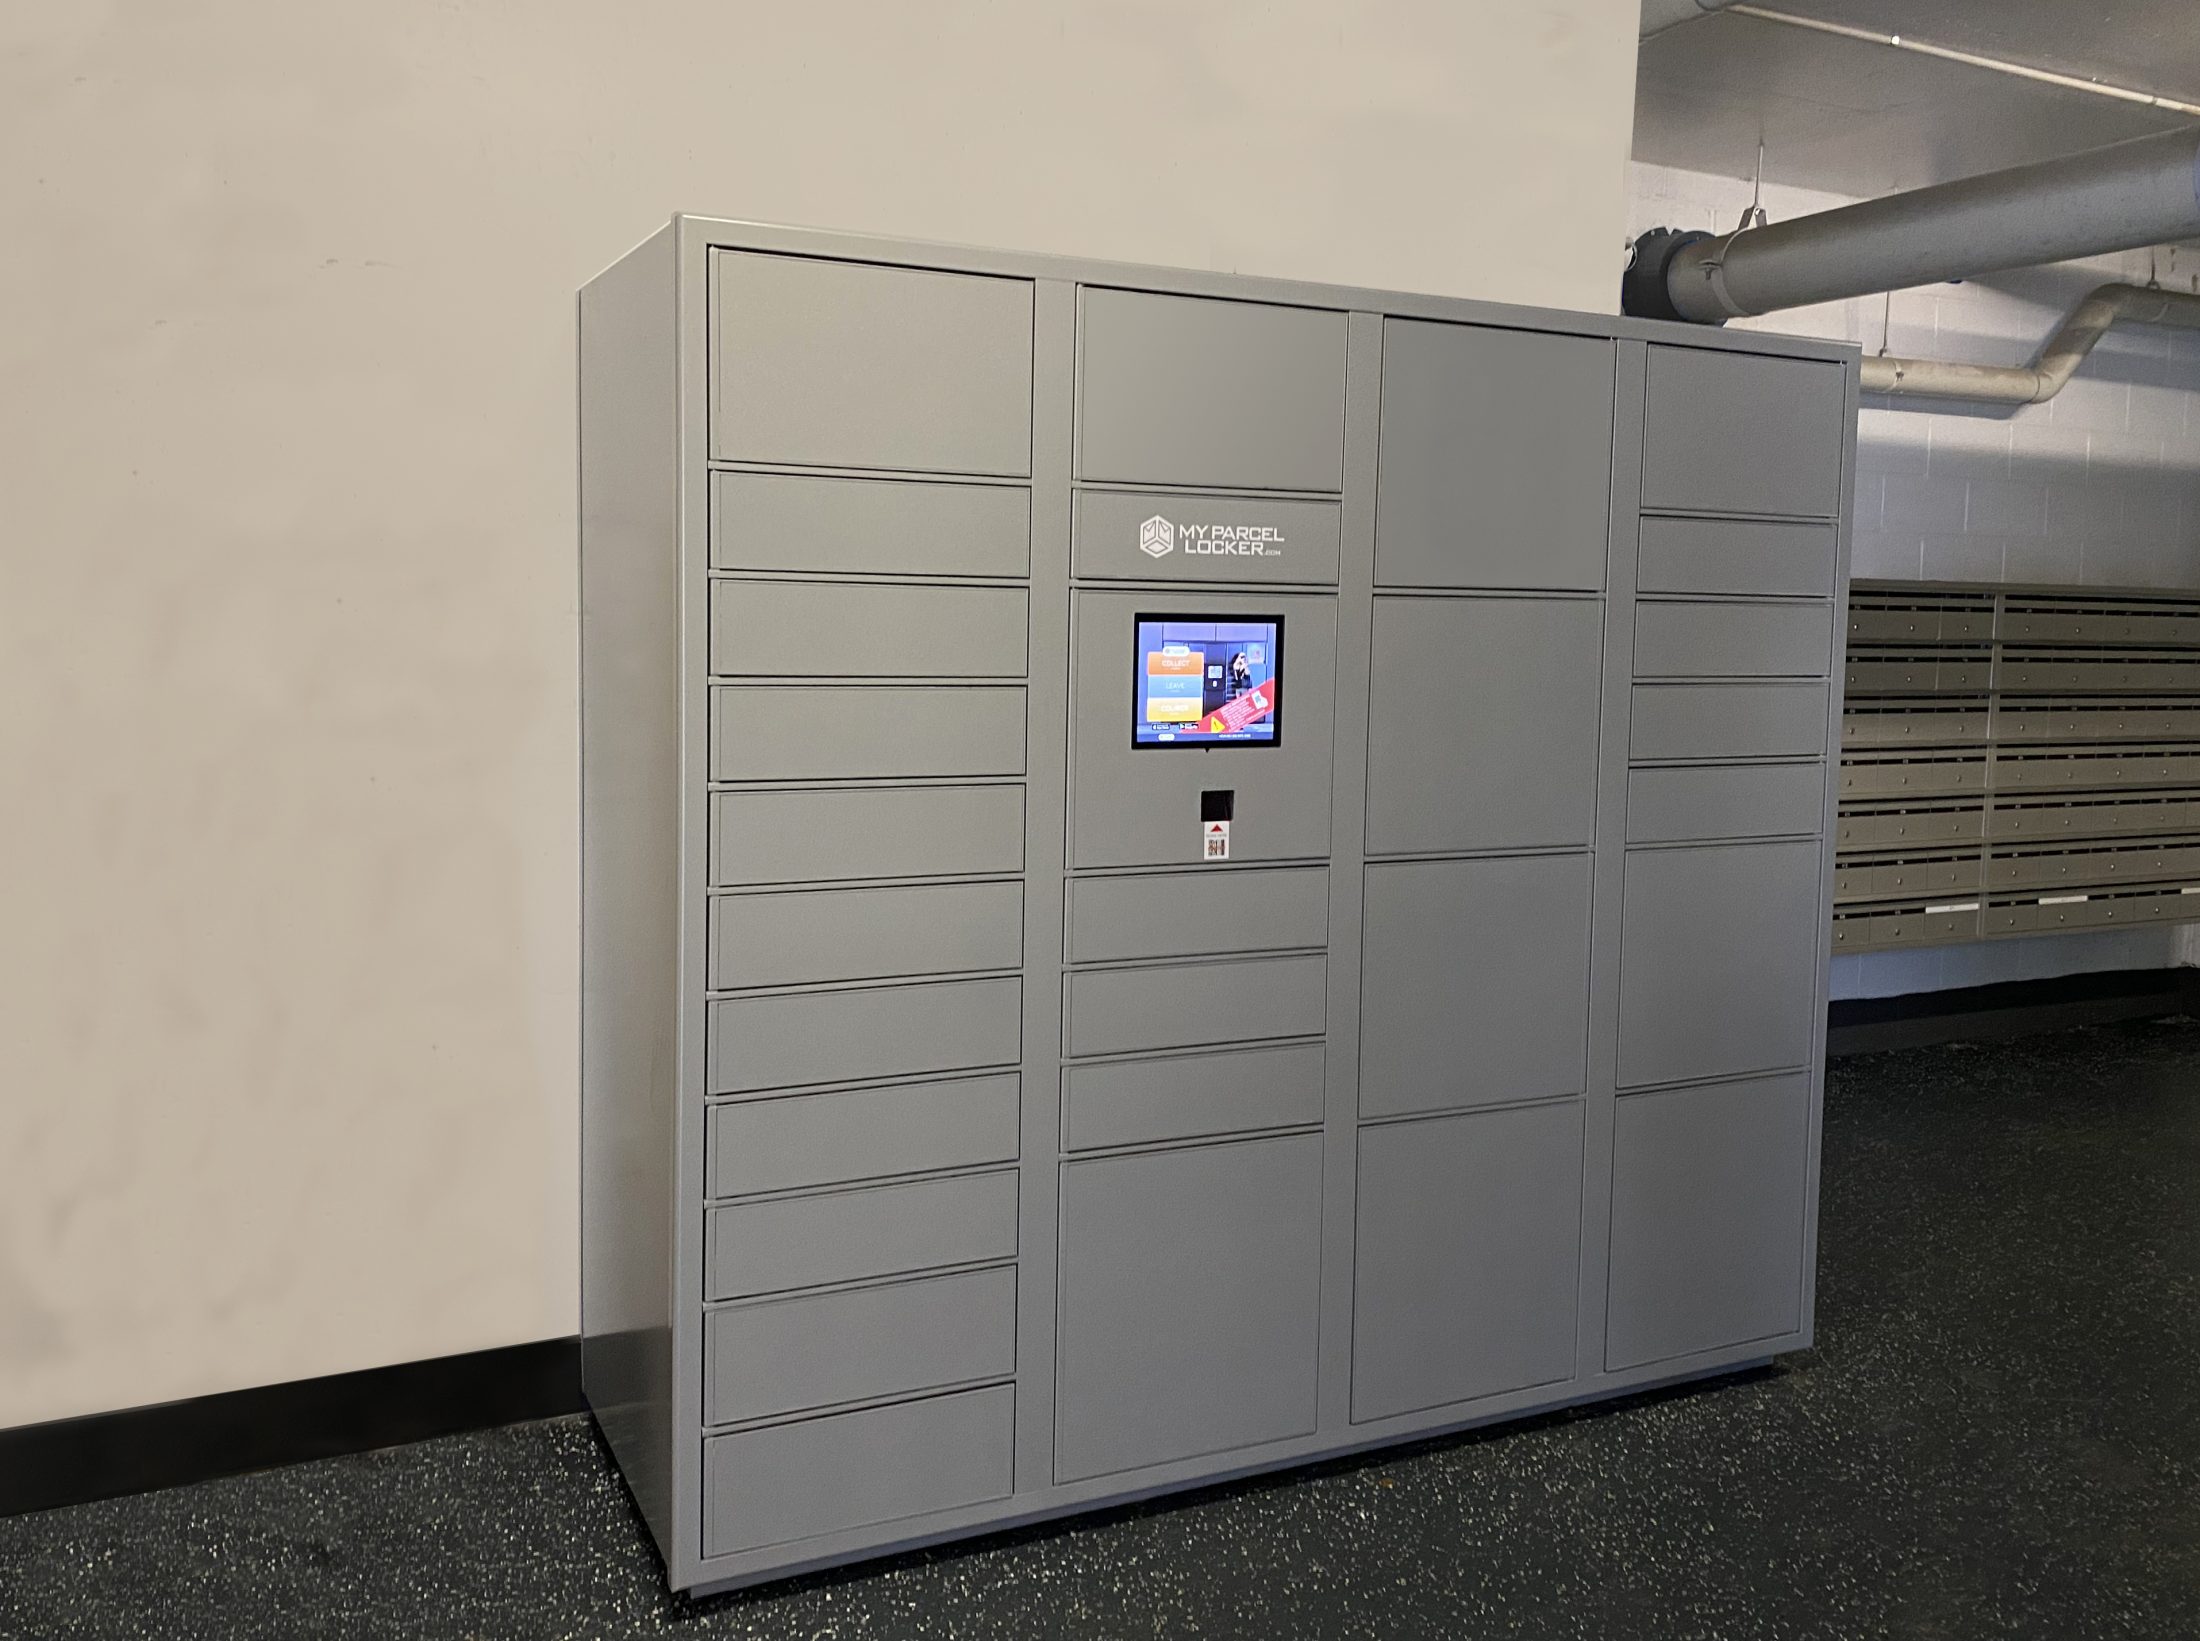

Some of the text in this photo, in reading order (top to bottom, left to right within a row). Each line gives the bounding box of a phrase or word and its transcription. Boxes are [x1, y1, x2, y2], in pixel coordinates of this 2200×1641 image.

[1179, 524, 1285, 542] MY PARCEL
[1185, 539, 1263, 556] LOCKER
[1161, 659, 1190, 667] COLLECT
[1165, 681, 1185, 689] LEAVE
